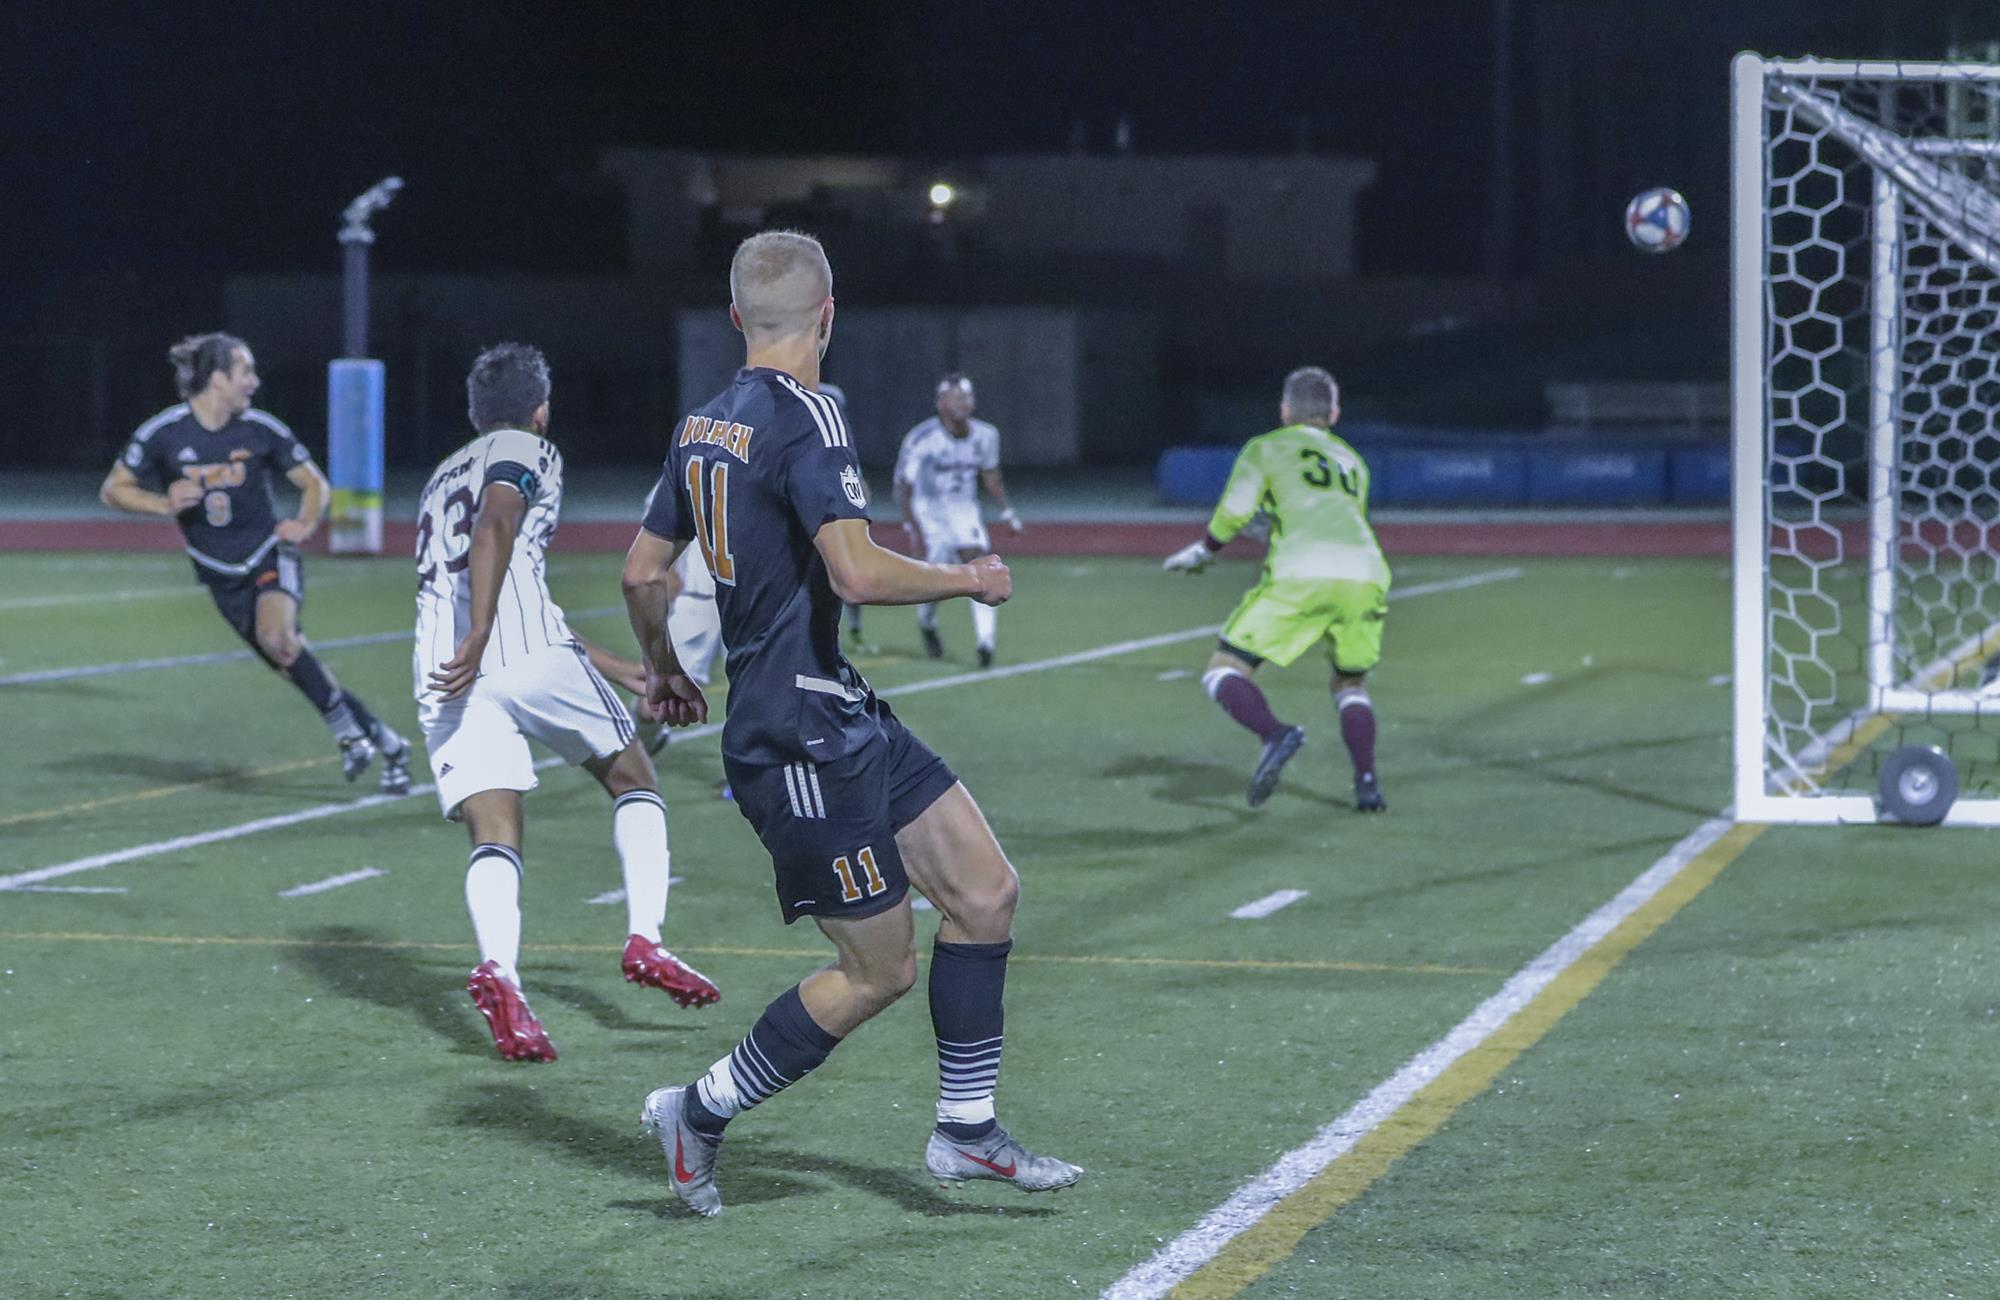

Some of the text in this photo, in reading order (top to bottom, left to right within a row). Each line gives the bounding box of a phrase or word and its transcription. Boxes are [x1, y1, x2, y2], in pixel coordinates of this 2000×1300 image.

[416, 485, 476, 590] 23
[686, 454, 736, 587] 11
[832, 845, 888, 904] 11
